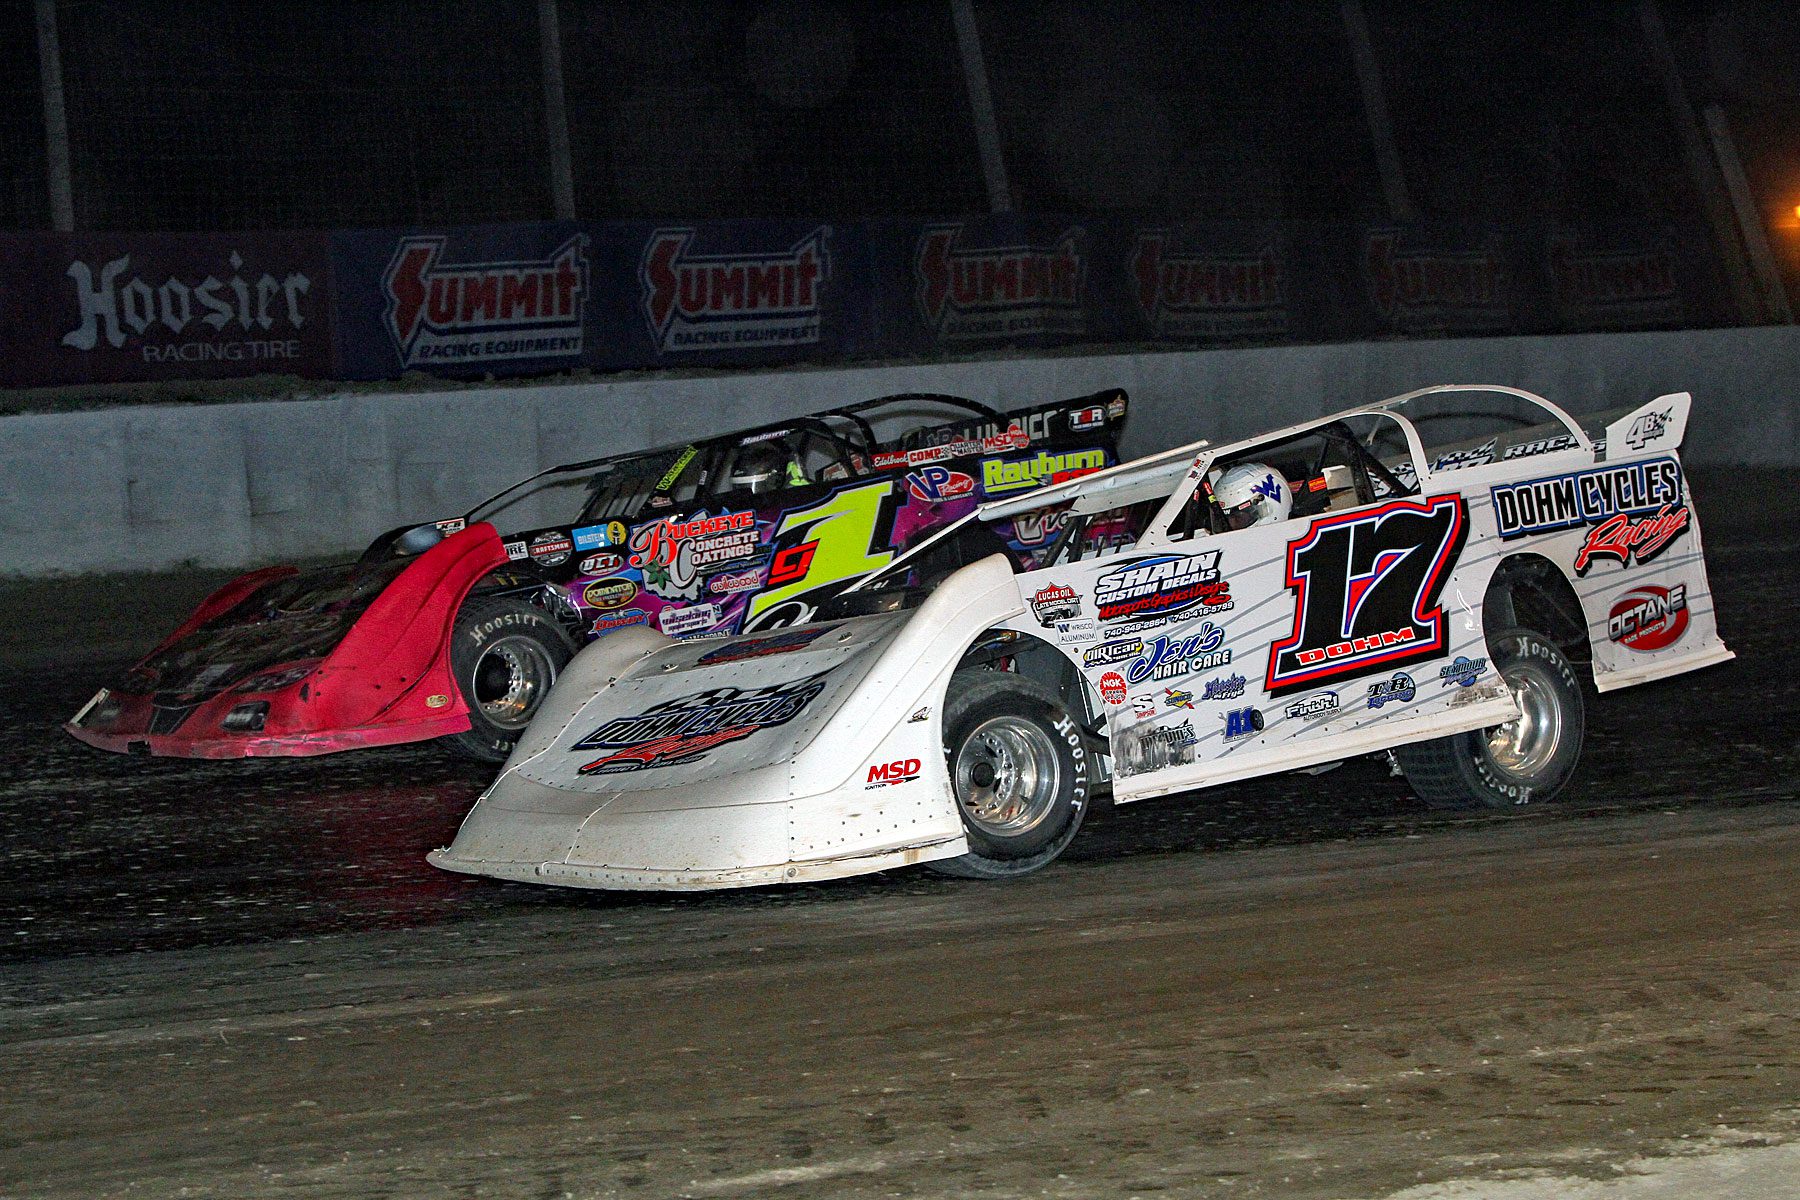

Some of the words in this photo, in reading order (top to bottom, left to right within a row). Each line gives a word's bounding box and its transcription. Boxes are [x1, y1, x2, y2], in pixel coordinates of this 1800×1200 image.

[391, 245, 580, 340] SUMMIT
[645, 236, 820, 328] SUMMIT
[59, 250, 311, 350] Hoosier
[143, 342, 244, 362] RACING
[245, 339, 301, 359] TIRE
[420, 344, 480, 358] RACING
[484, 337, 581, 355] EQUIPMENT
[672, 326, 730, 345] RACING
[734, 322, 819, 343] EQUIPMENT
[910, 448, 941, 463] COMP
[982, 449, 1104, 486] Rayburn
[906, 466, 950, 500] VP
[1494, 477, 1580, 533] DOHM
[1578, 460, 1679, 518] CYCLES
[629, 511, 754, 567] BUCKEYE
[1574, 503, 1689, 571] Racing
[1095, 551, 1219, 593] SHAIN
[1096, 583, 1160, 605] CUSTOM
[1161, 568, 1217, 590] DECALS
[1036, 601, 1050, 610] LATE
[1038, 591, 1059, 601] LUCAS
[1060, 589, 1072, 598] OIL
[1272, 496, 1463, 684] 17
[1071, 622, 1093, 630] WRISCO
[1608, 584, 1685, 640] OCTANE
[470, 614, 538, 648] Hoosier
[1061, 633, 1096, 643] ALUMINUM
[1295, 627, 1416, 666] DOHM
[1128, 622, 1224, 683] Jen's
[1154, 659, 1187, 680] HAIR
[1190, 650, 1231, 672] CARE
[1517, 636, 1575, 688] Hoosier
[1103, 679, 1122, 688] NGK
[1202, 673, 1246, 700] Hoosier
[1136, 709, 1156, 719] SIMPSON
[867, 758, 921, 783] MSD
[1054, 713, 1088, 812] Hoosier
